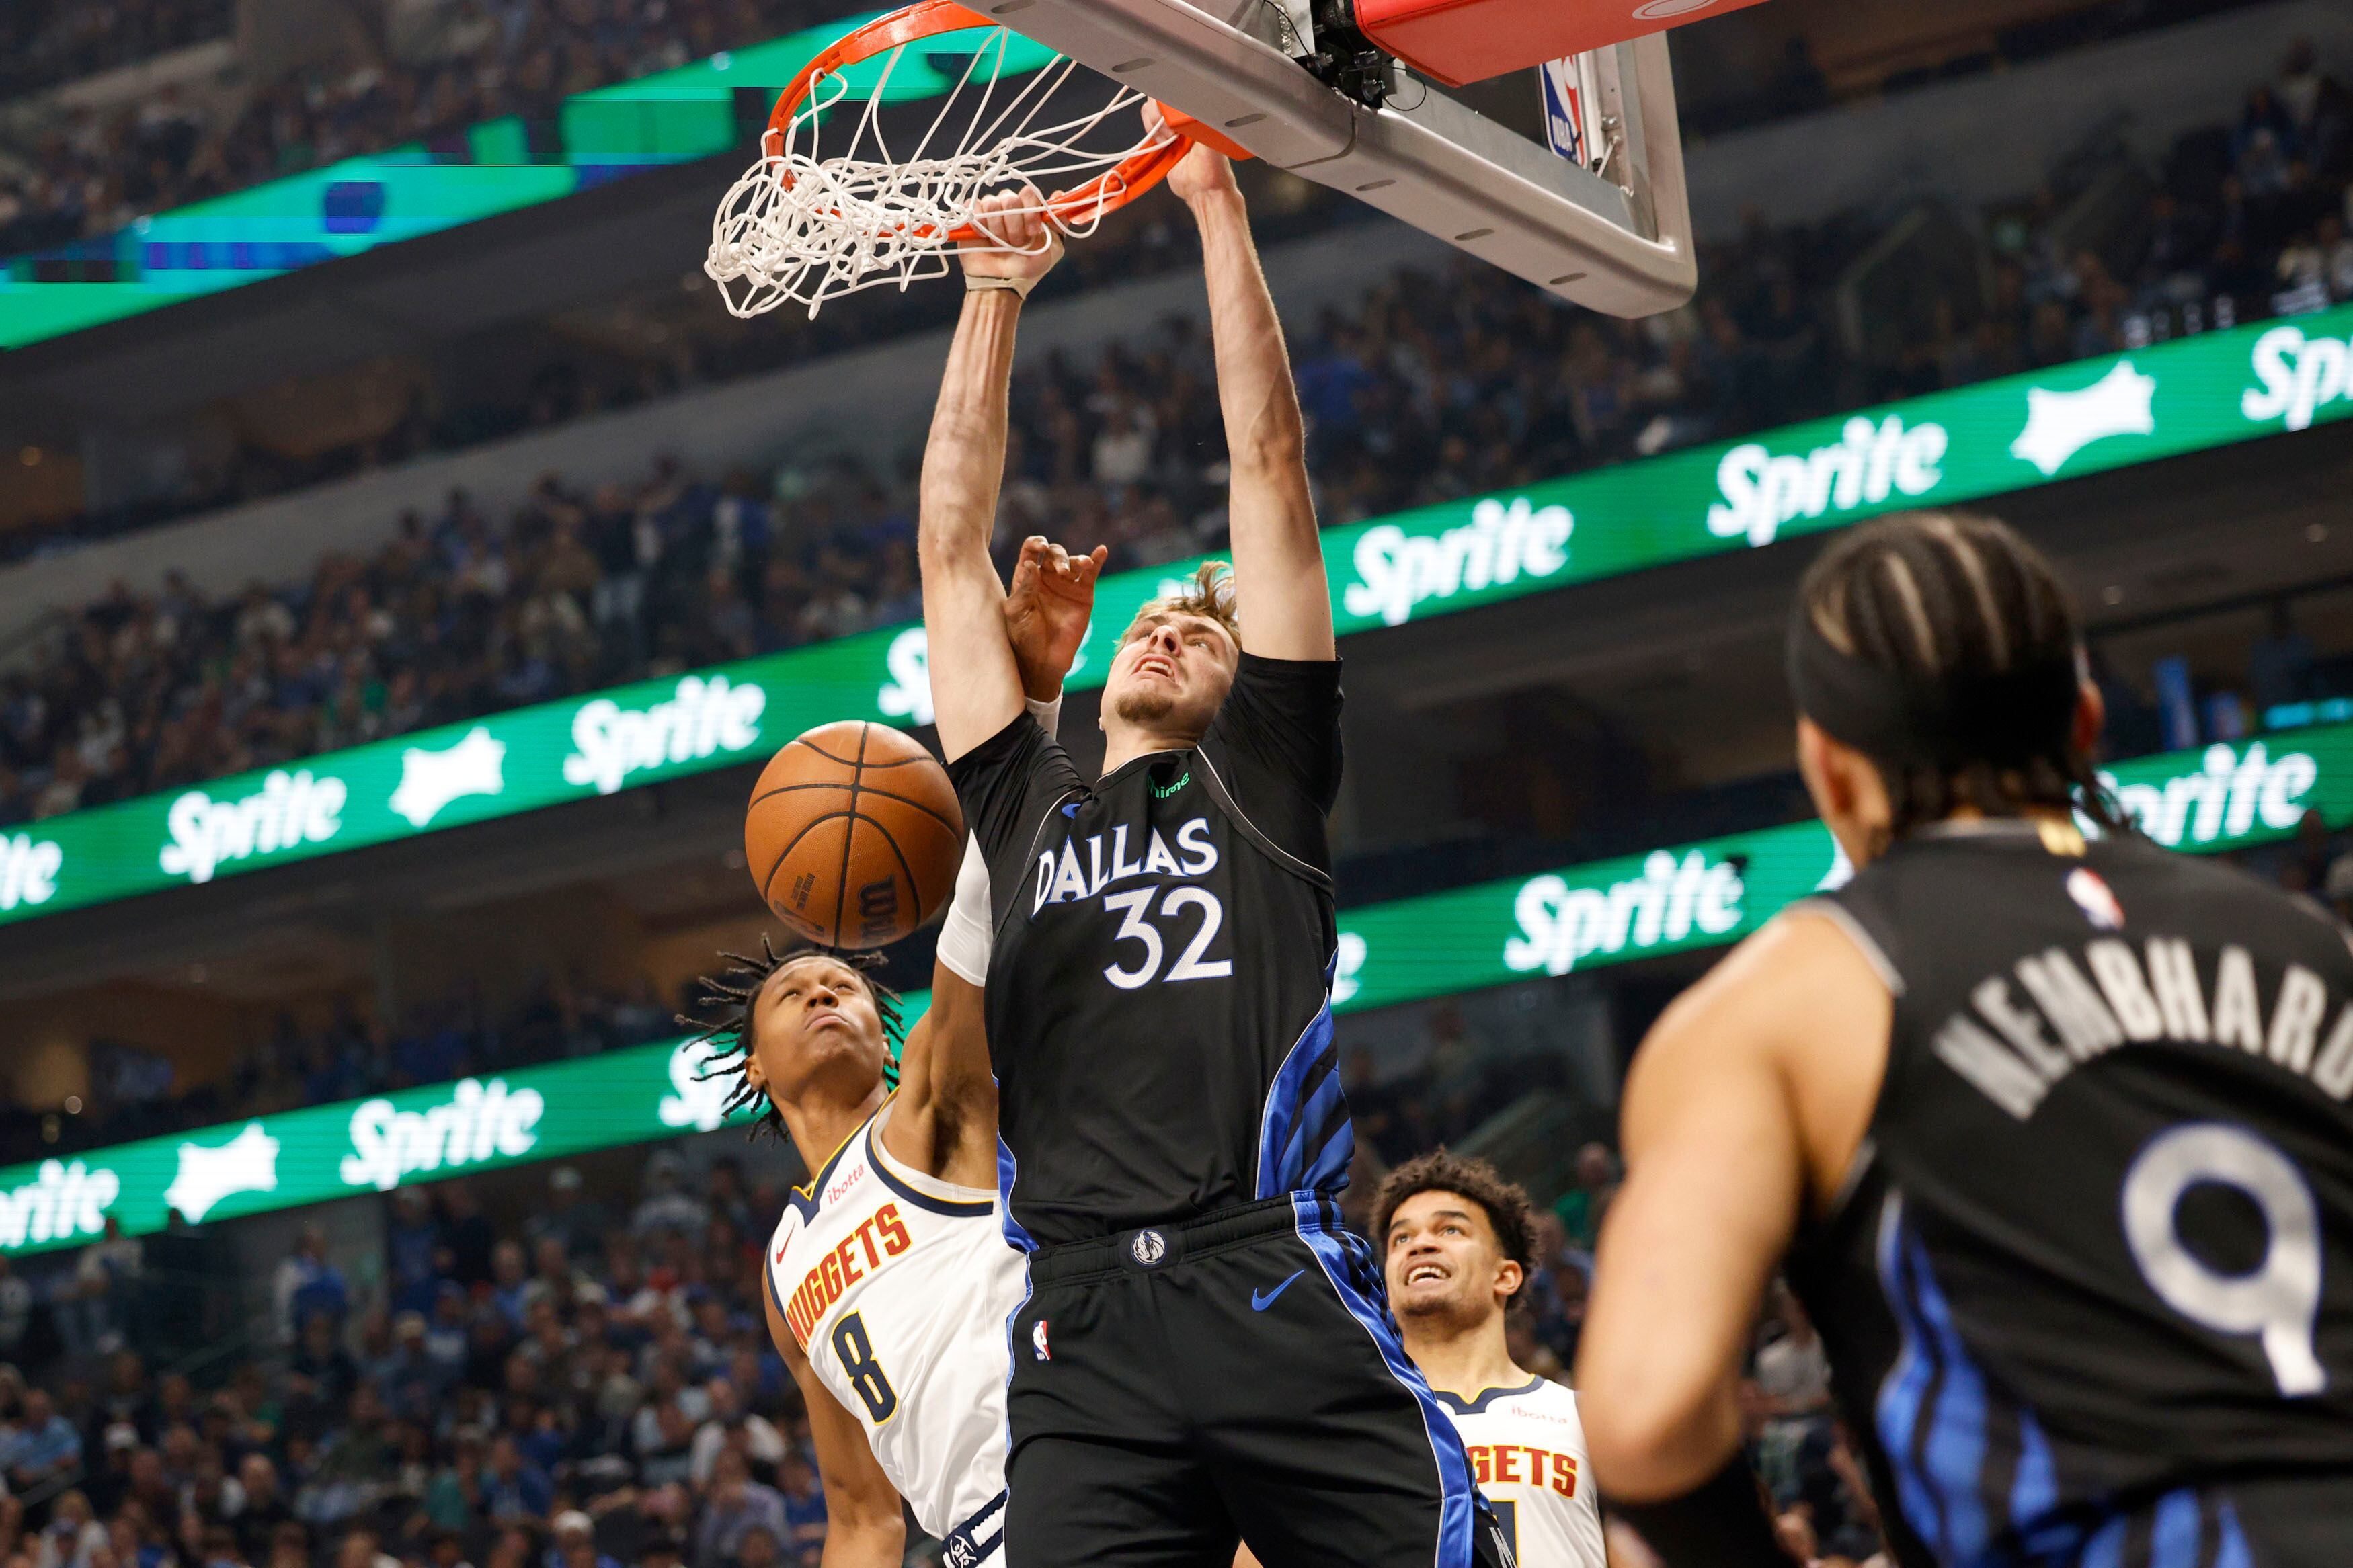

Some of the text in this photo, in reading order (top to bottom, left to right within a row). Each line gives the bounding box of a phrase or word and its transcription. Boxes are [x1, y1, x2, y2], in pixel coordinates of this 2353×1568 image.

[1708, 416, 1947, 548] Sprite
[1345, 497, 1574, 626] Sprite
[563, 675, 766, 794] Sprite
[160, 770, 347, 884] Sprite
[2073, 743, 2317, 846] rite
[1031, 817, 1218, 919] DALLAS
[1503, 850, 1744, 975] Sprite
[1103, 885, 1233, 990] 32
[340, 1078, 544, 1191] Sprite
[827, 1163, 865, 1205] ibotta
[0, 1158, 120, 1248] rite
[2120, 1120, 2326, 1396] 9
[785, 1202, 914, 1354] NUGGETS
[832, 1308, 899, 1426] 8
